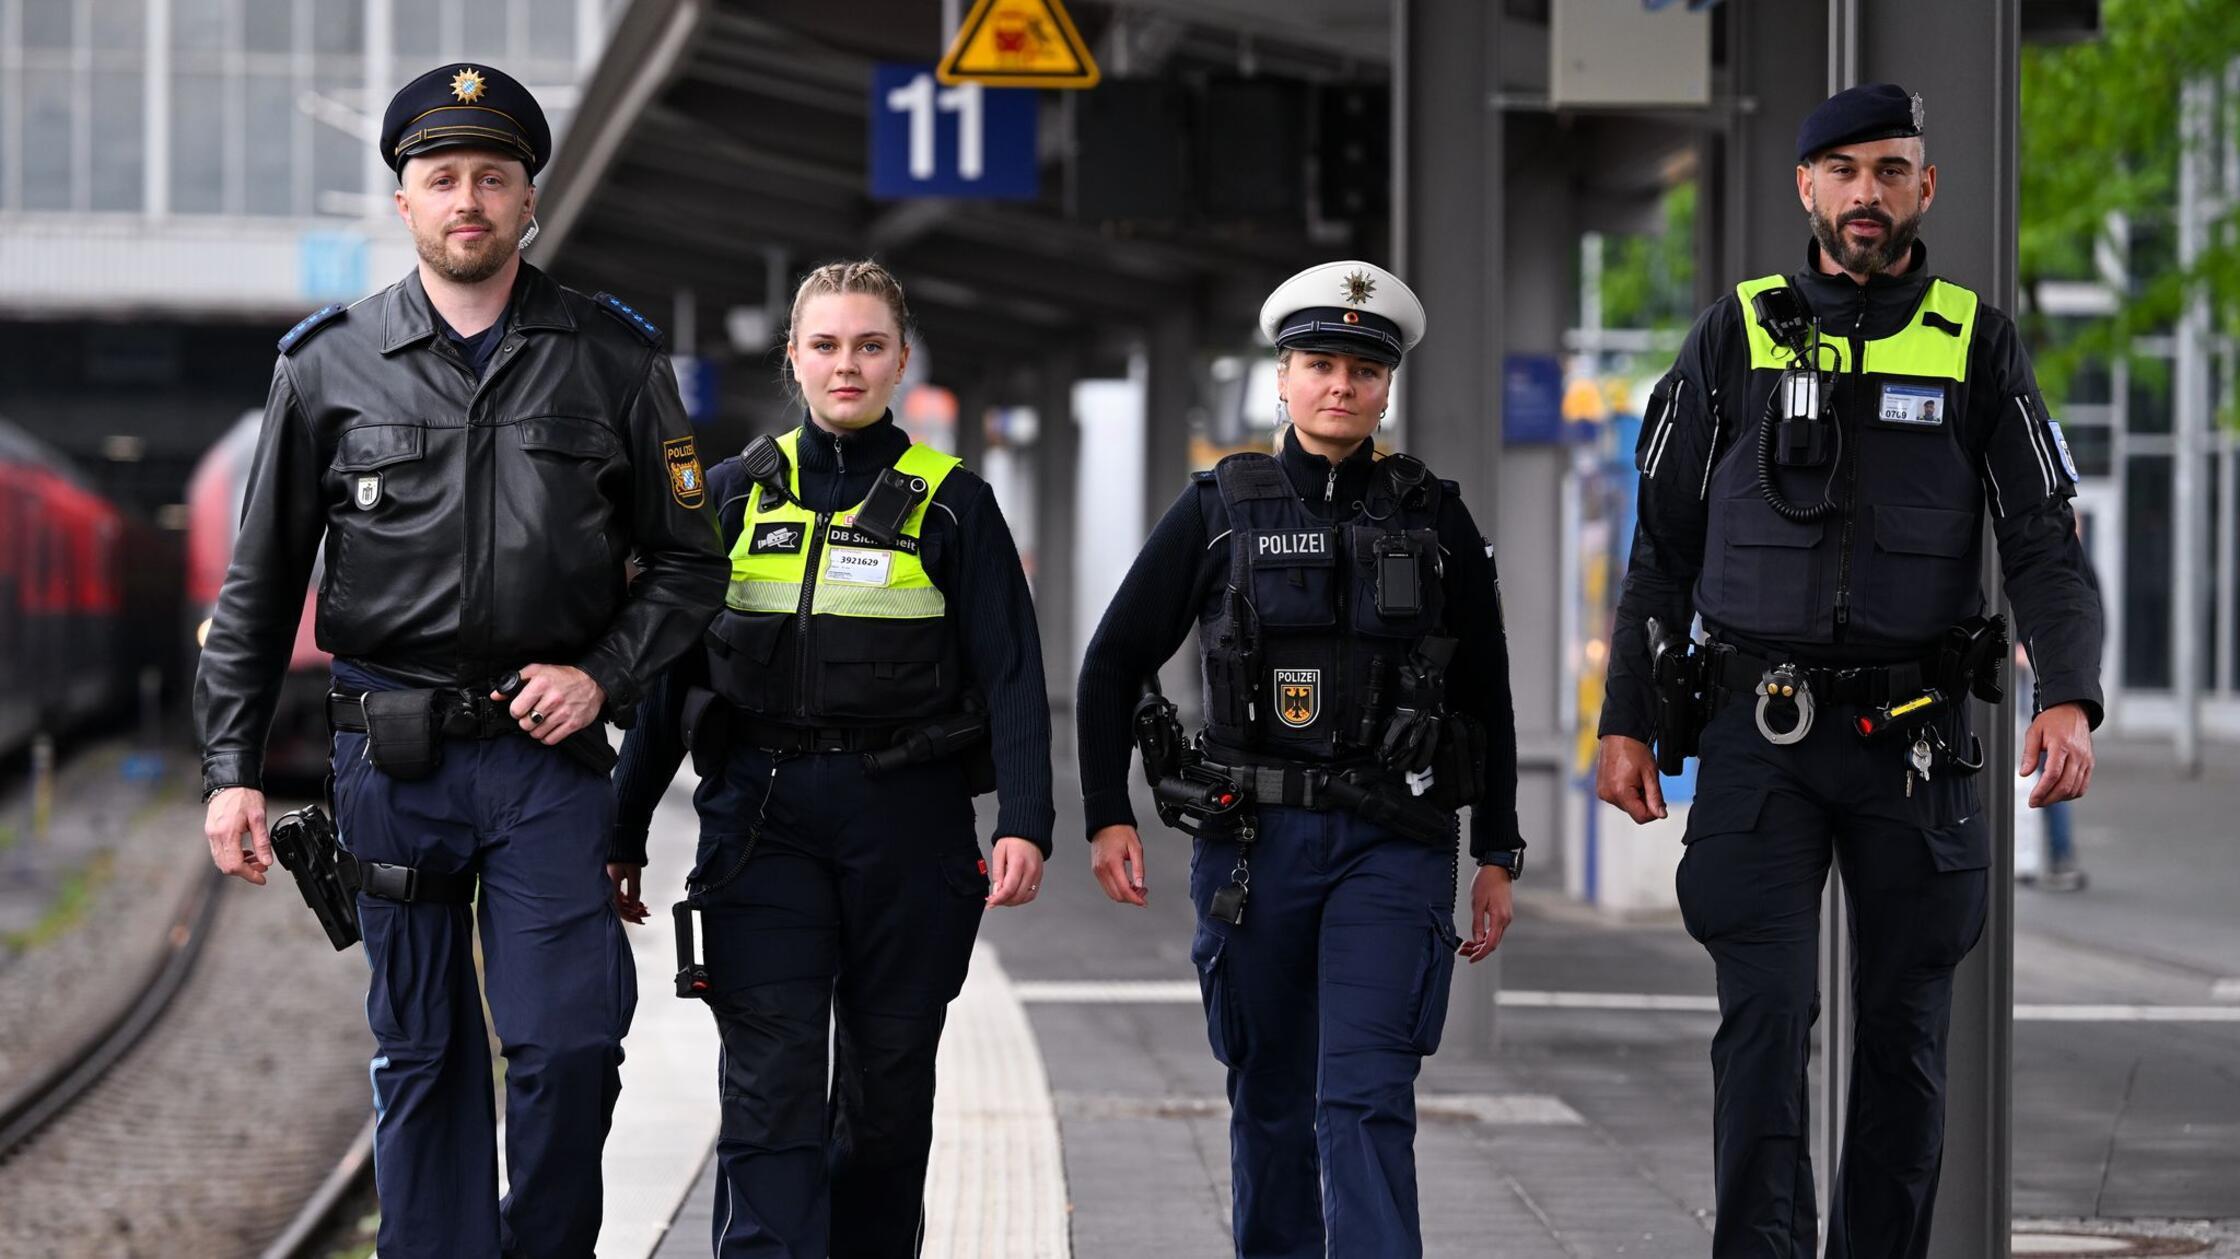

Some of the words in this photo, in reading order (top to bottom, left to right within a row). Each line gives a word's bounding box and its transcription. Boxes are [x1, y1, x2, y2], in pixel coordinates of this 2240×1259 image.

[887, 74, 984, 181] 11
[830, 530, 850, 541] DB
[1259, 533, 1325, 555] POLIZEI
[840, 556, 879, 567] 3921629
[1278, 672, 1316, 682] POLIZEI
